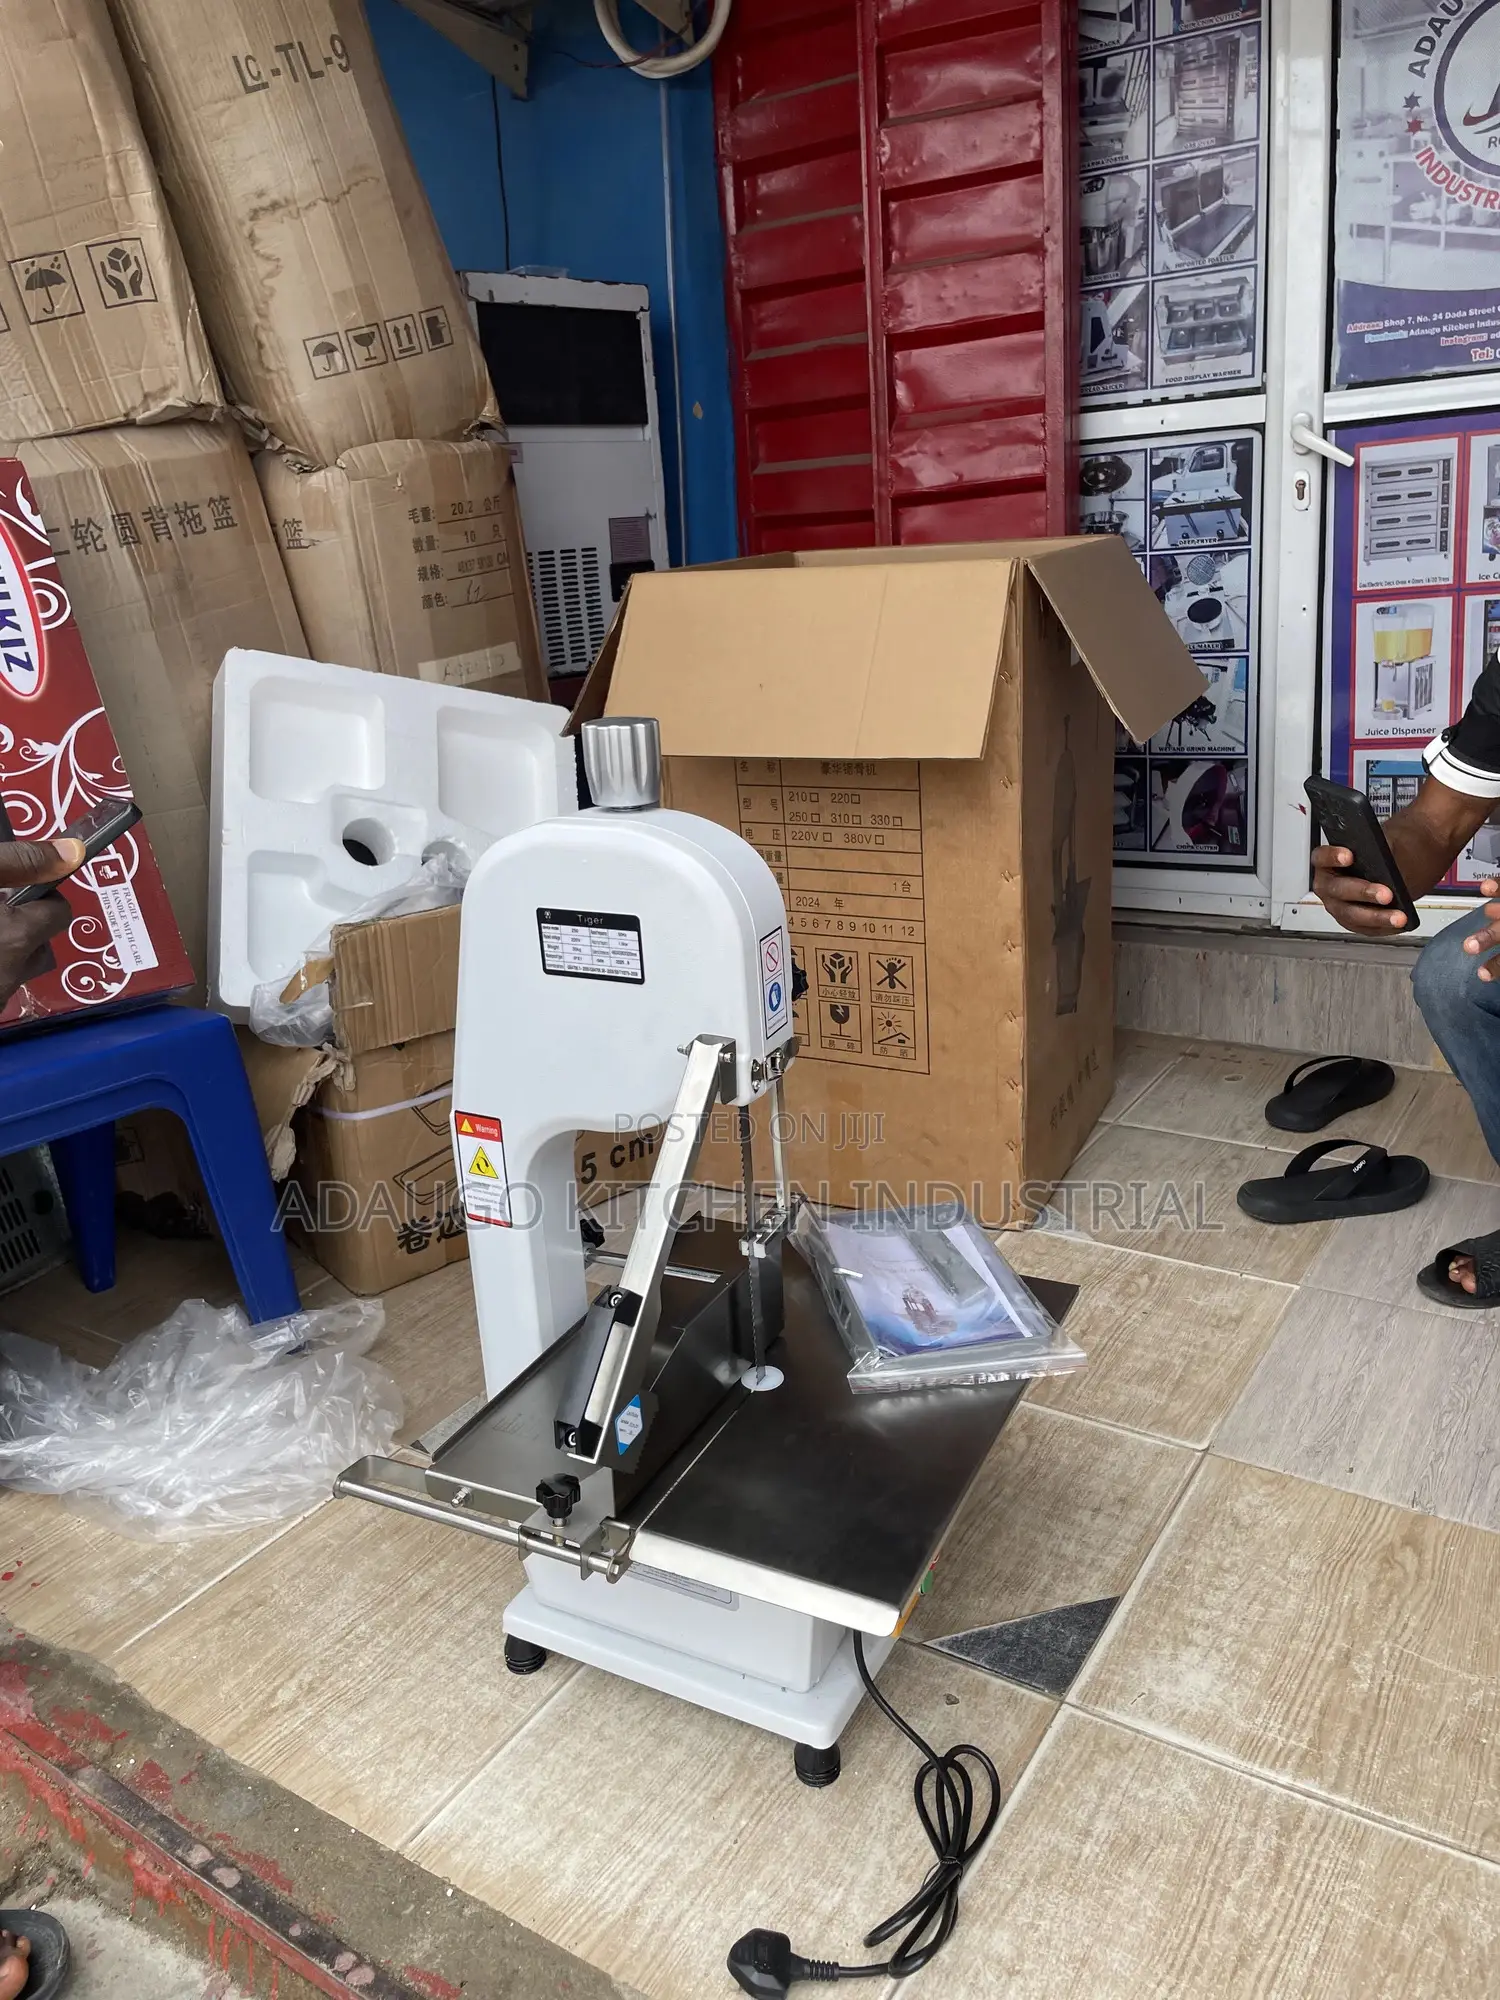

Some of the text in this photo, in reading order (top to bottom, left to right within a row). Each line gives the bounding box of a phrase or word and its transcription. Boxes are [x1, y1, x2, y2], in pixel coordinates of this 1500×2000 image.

[1384, 319, 1406, 328] Shop
[1416, 315, 1431, 323] No.
[1432, 312, 1443, 321] 24
[1444, 310, 1467, 319] Dada
[1468, 305, 1496, 316] Street
[1442, 322, 1475, 333] Kitchen
[1471, 347, 1494, 362] Tel:
[1165, 369, 1242, 383] FOOD DISPLAY WARMER
[451, 501, 474, 516] 20.2
[464, 530, 477, 544] 10
[1195, 537, 1218, 545] FRYER
[1478, 573, 1491, 581] Ice
[1365, 727, 1437, 737] Juice Dispenser
[788, 791, 808, 803] 210
[830, 792, 850, 805] 220
[789, 811, 890, 826] 250 310 330
[791, 830, 819, 842] 220V
[843, 832, 873, 845] 380V
[901, 880, 912, 894] 台
[122, 887, 140, 922] FRAGILE
[795, 896, 845, 910] 2024 年
[100, 891, 122, 940] THIS SIDE UP
[577, 914, 604, 926] Tiger
[111, 889, 143, 966] HANDLE WITH CARE
[788, 916, 915, 937] 4 5 6 7 8 9 10 11 12
[474, 1122, 499, 1138] Warning
[609, 1132, 655, 1169] cm
